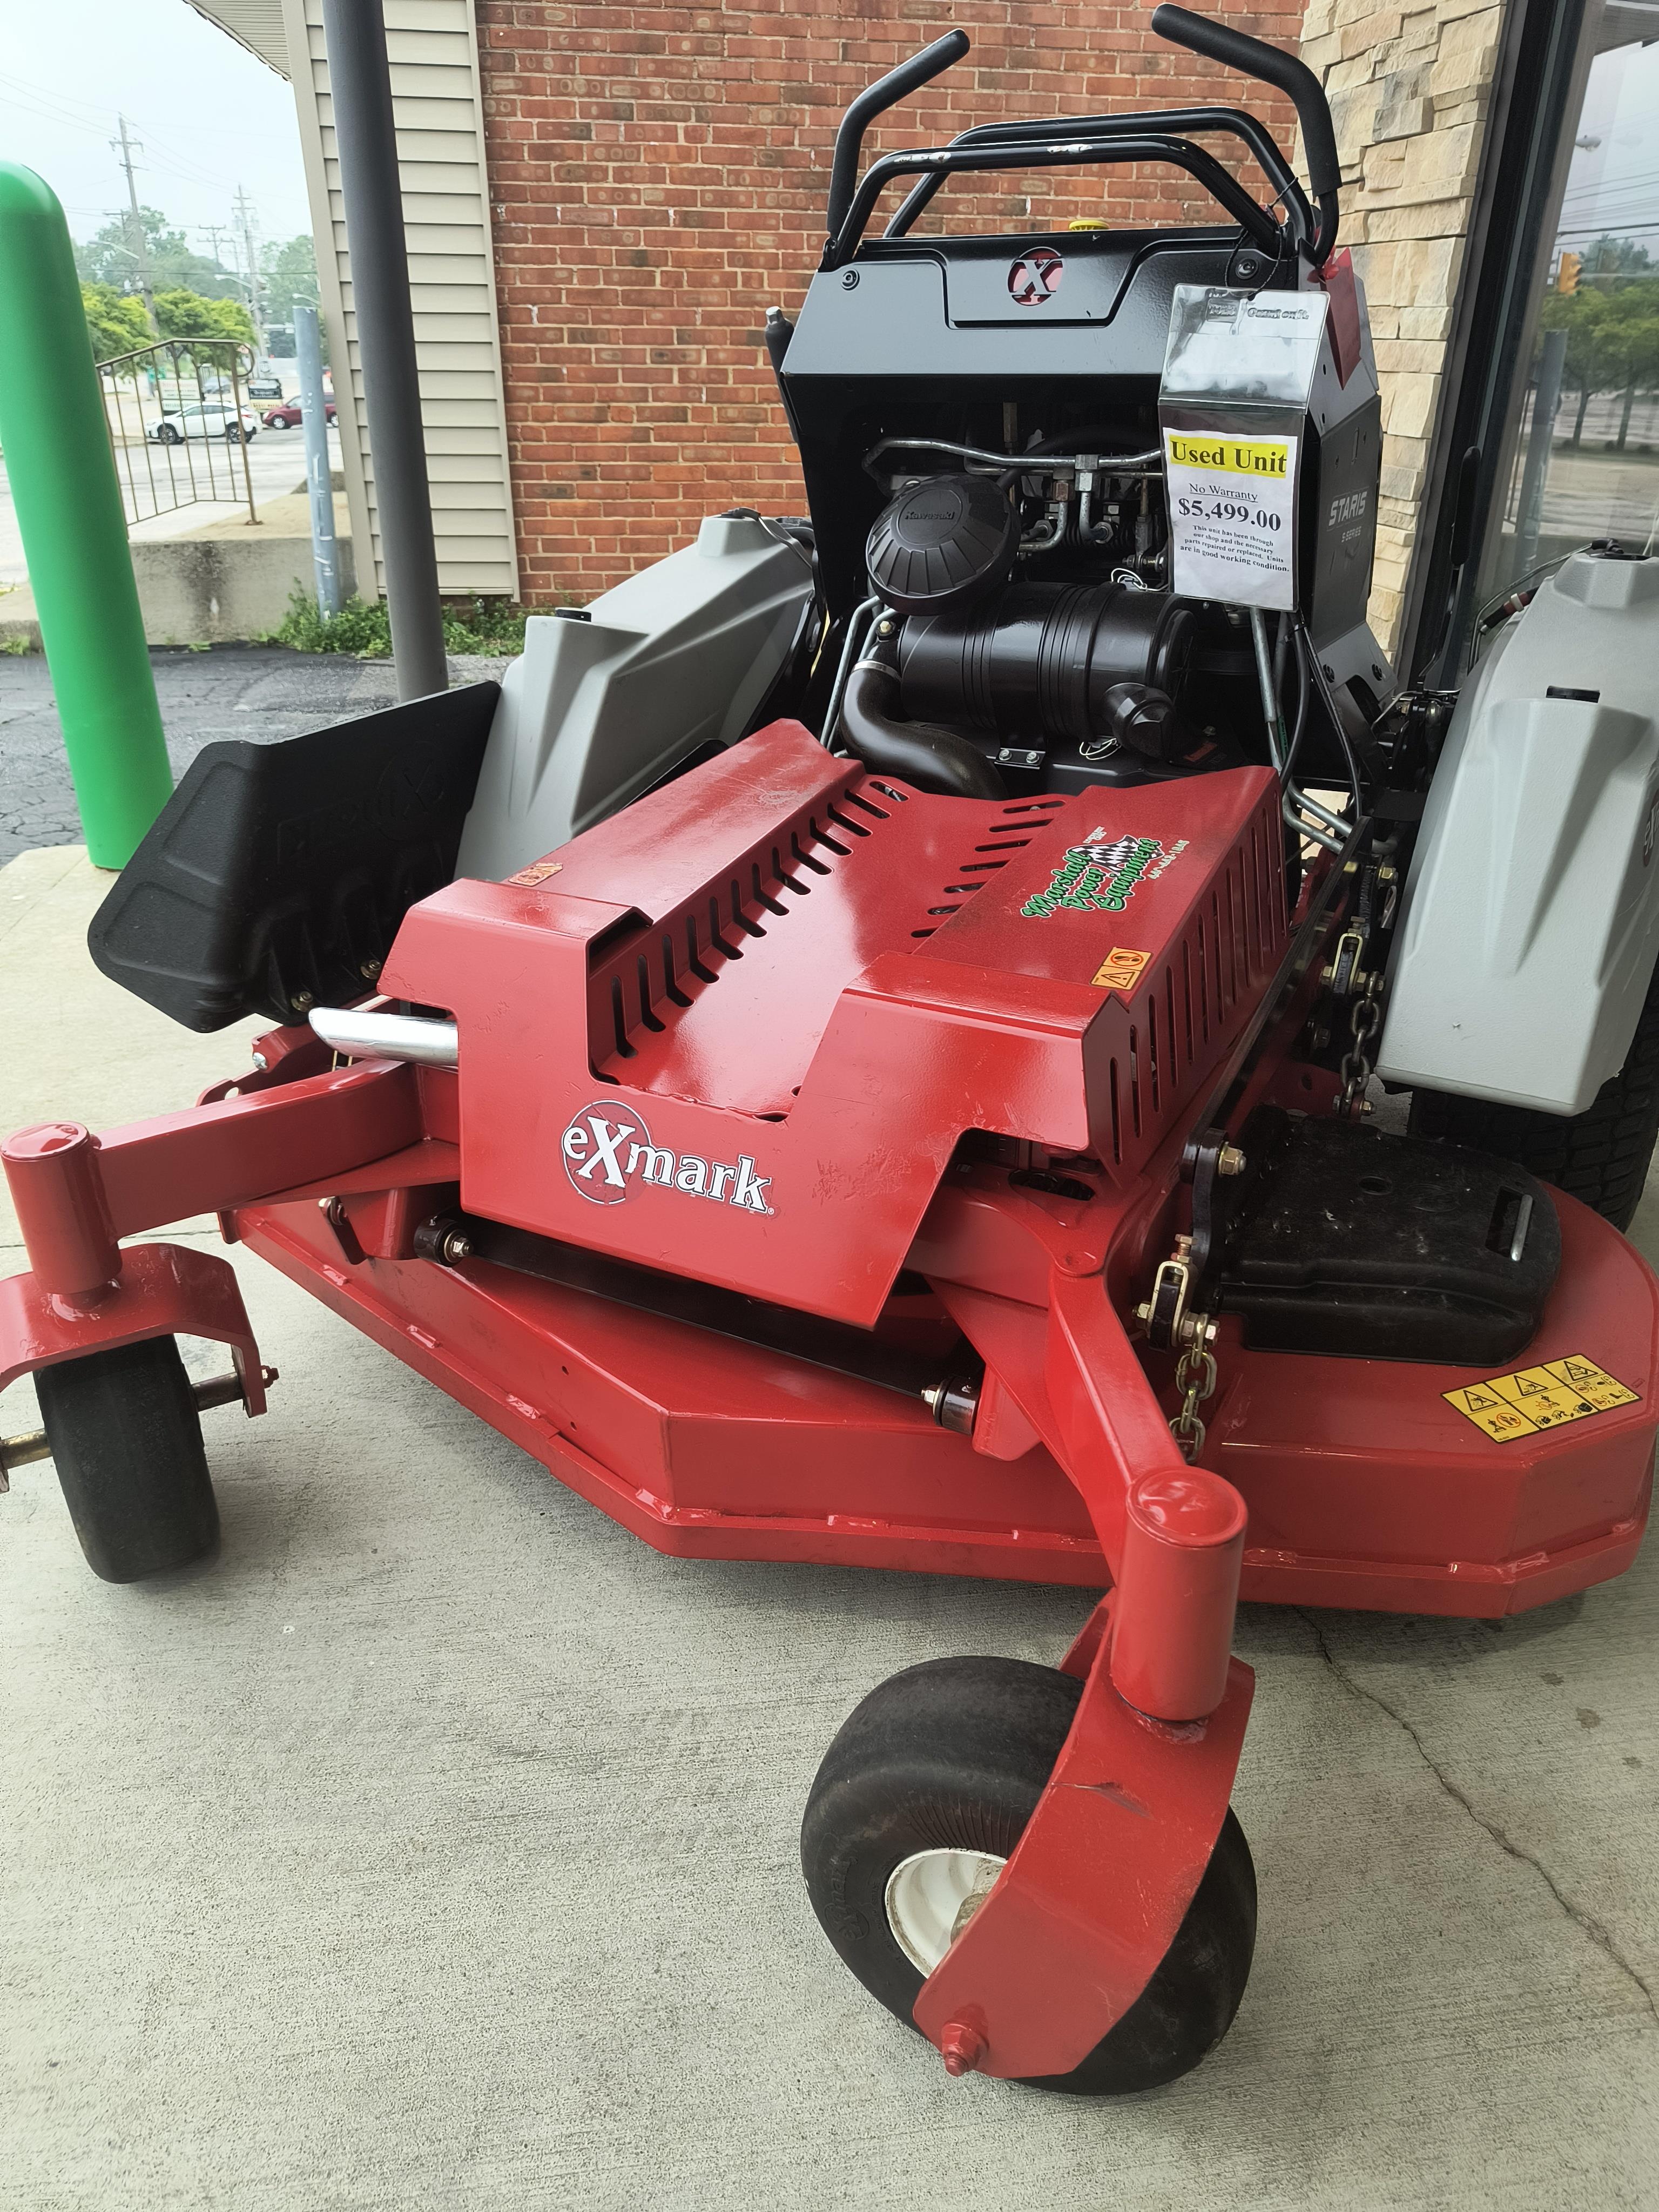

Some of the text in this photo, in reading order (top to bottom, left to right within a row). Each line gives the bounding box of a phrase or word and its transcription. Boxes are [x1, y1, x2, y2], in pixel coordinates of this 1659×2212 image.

[1170, 440, 1287, 473] Used Unit
[1189, 483, 1258, 502] No Warranty
[905, 511, 955, 520] Kawasaki
[1178, 498, 1281, 531] $5,499.00
[1328, 491, 1367, 527] STARIS
[1202, 541, 1226, 551] repaired
[1237, 549, 1264, 560] replaced.
[1205, 534, 1219, 543] shop
[1245, 543, 1273, 555] necessary
[1250, 535, 1273, 547] through
[1202, 550, 1218, 558] good
[1220, 554, 1251, 565] working
[1253, 561, 1289, 572] condition.
[1021, 850, 1093, 917] Marshall
[1092, 838, 1161, 911] Equipment
[1060, 867, 1107, 911] Power
